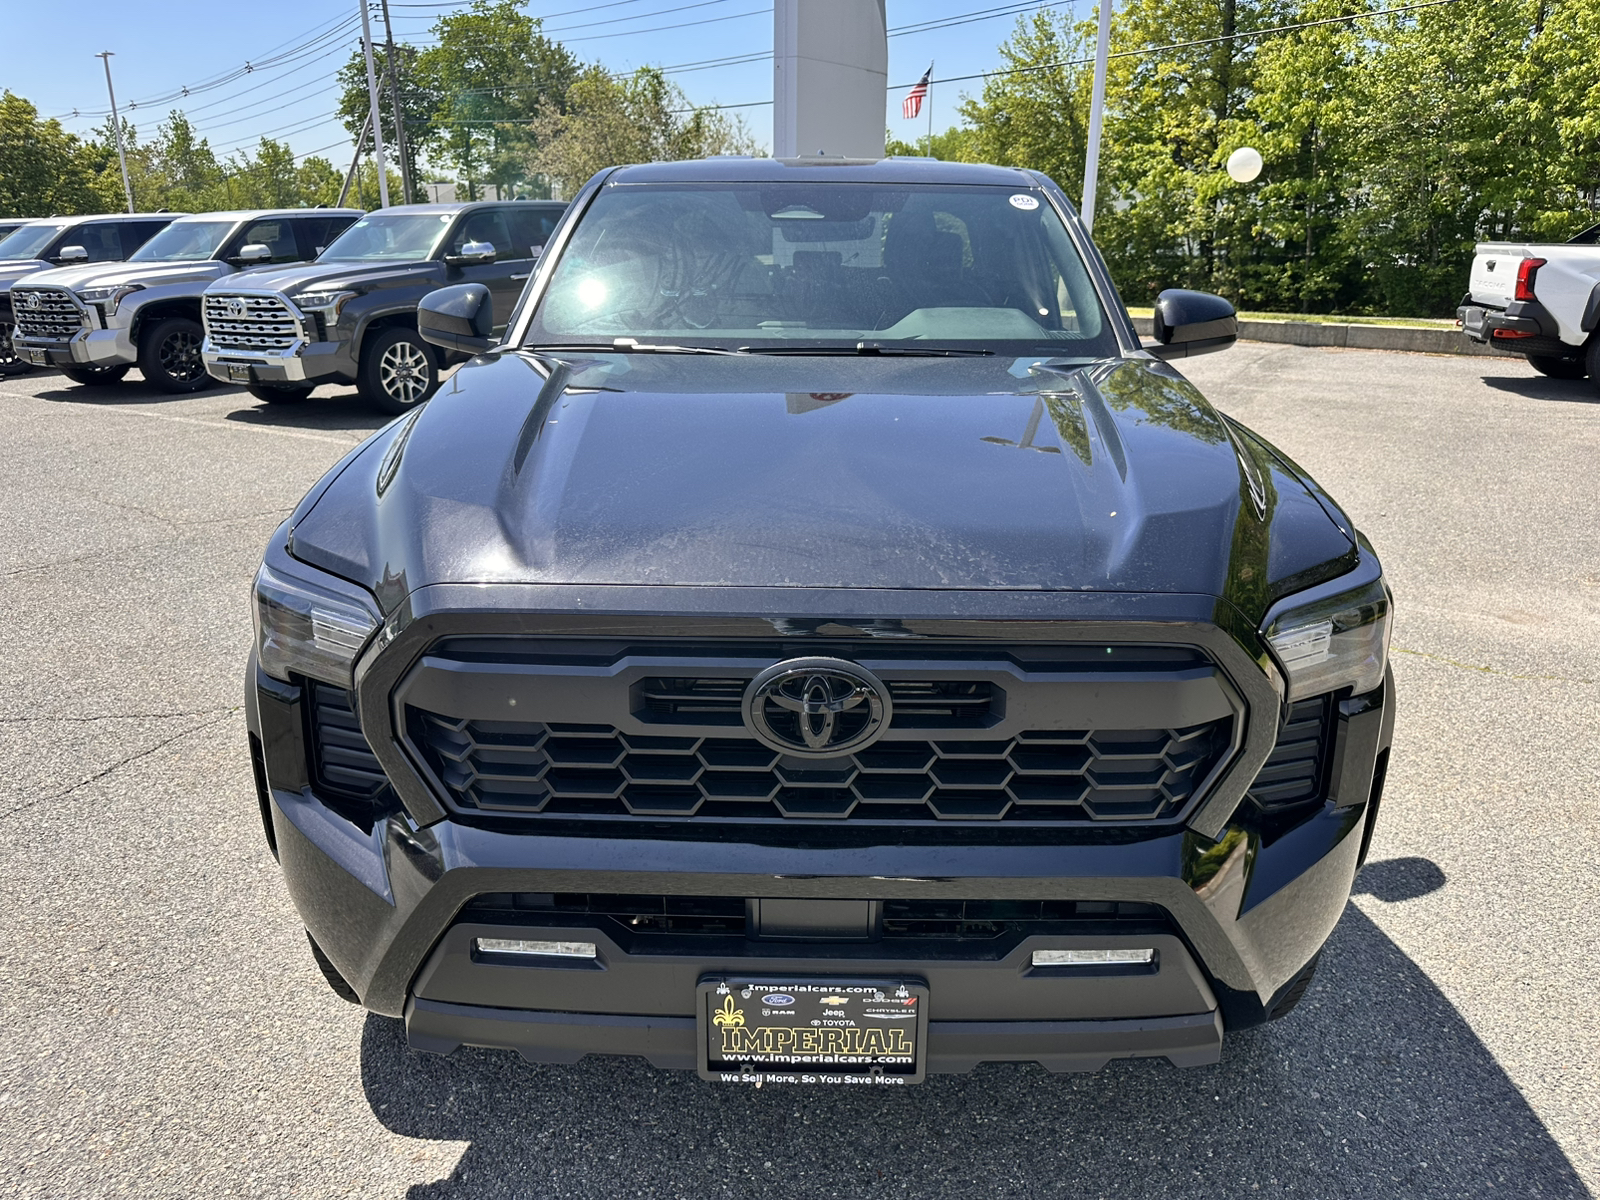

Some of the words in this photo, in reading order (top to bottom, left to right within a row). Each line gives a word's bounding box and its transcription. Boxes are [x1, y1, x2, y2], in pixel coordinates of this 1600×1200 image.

[748, 984, 877, 994] Imperialcars.com
[822, 1008, 845, 1018] Jeep
[721, 1027, 912, 1055] IMPERIAL
[722, 1053, 912, 1064] www.imperialcars.com
[720, 1073, 739, 1082] We
[742, 1073, 763, 1083] Sell
[766, 1074, 798, 1084] More,
[801, 1074, 816, 1083] So
[819, 1074, 841, 1084] You
[844, 1075, 872, 1084] Save
[875, 1076, 904, 1084] More
